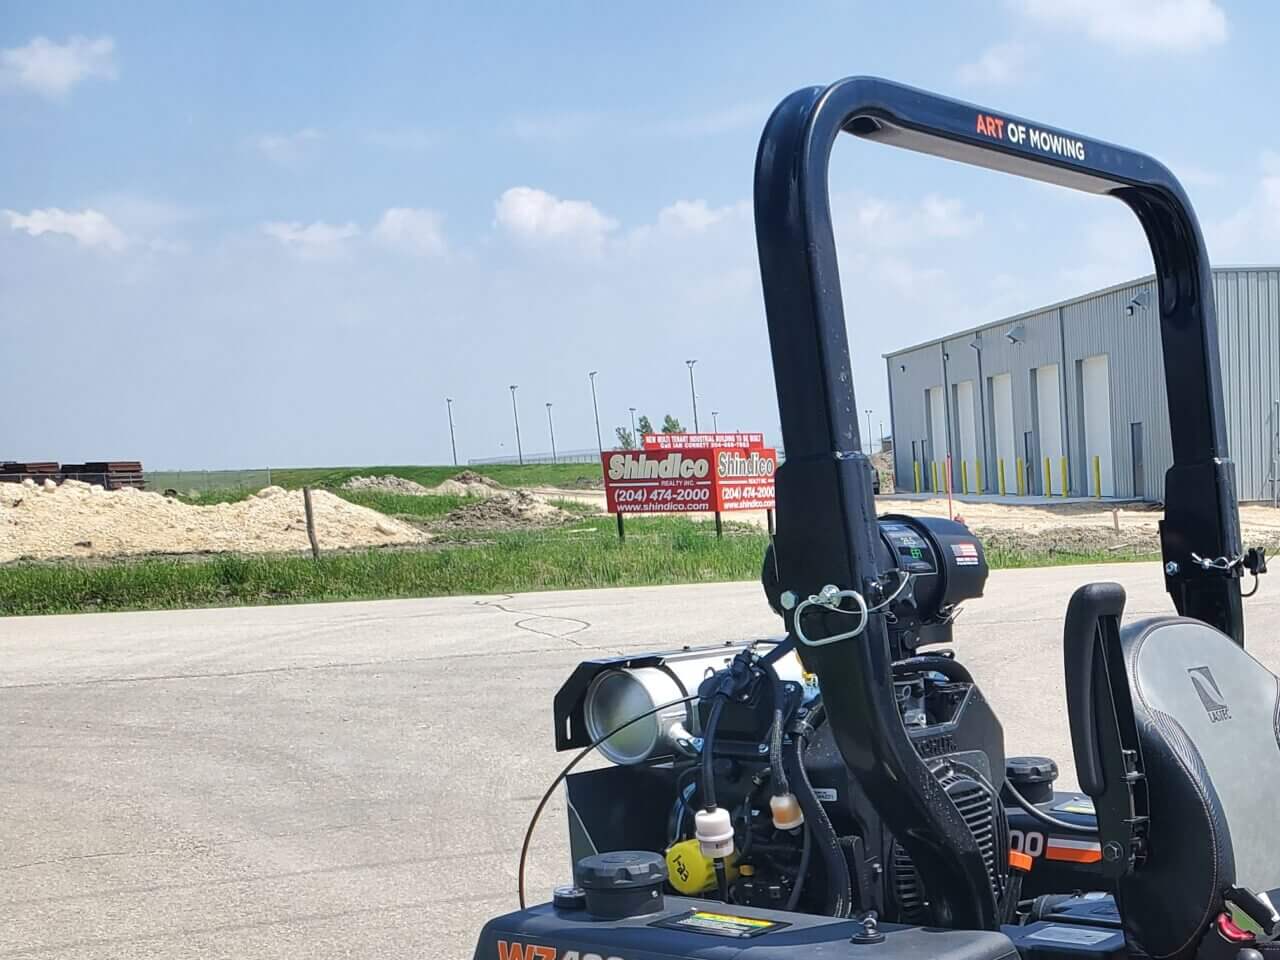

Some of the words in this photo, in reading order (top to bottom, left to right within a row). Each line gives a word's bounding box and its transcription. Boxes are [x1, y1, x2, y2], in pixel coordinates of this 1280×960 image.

[976, 114, 1003, 139] ART
[1007, 122, 1026, 145] OF
[1029, 129, 1085, 160] MOWING
[608, 454, 708, 479] Shindico
[718, 451, 774, 478] Shindico
[614, 488, 647, 502] (204)
[649, 489, 709, 501] 474-2000
[722, 486, 742, 500] (204)
[743, 485, 775, 499] 474-2000
[616, 502, 709, 512] www.shindico.com
